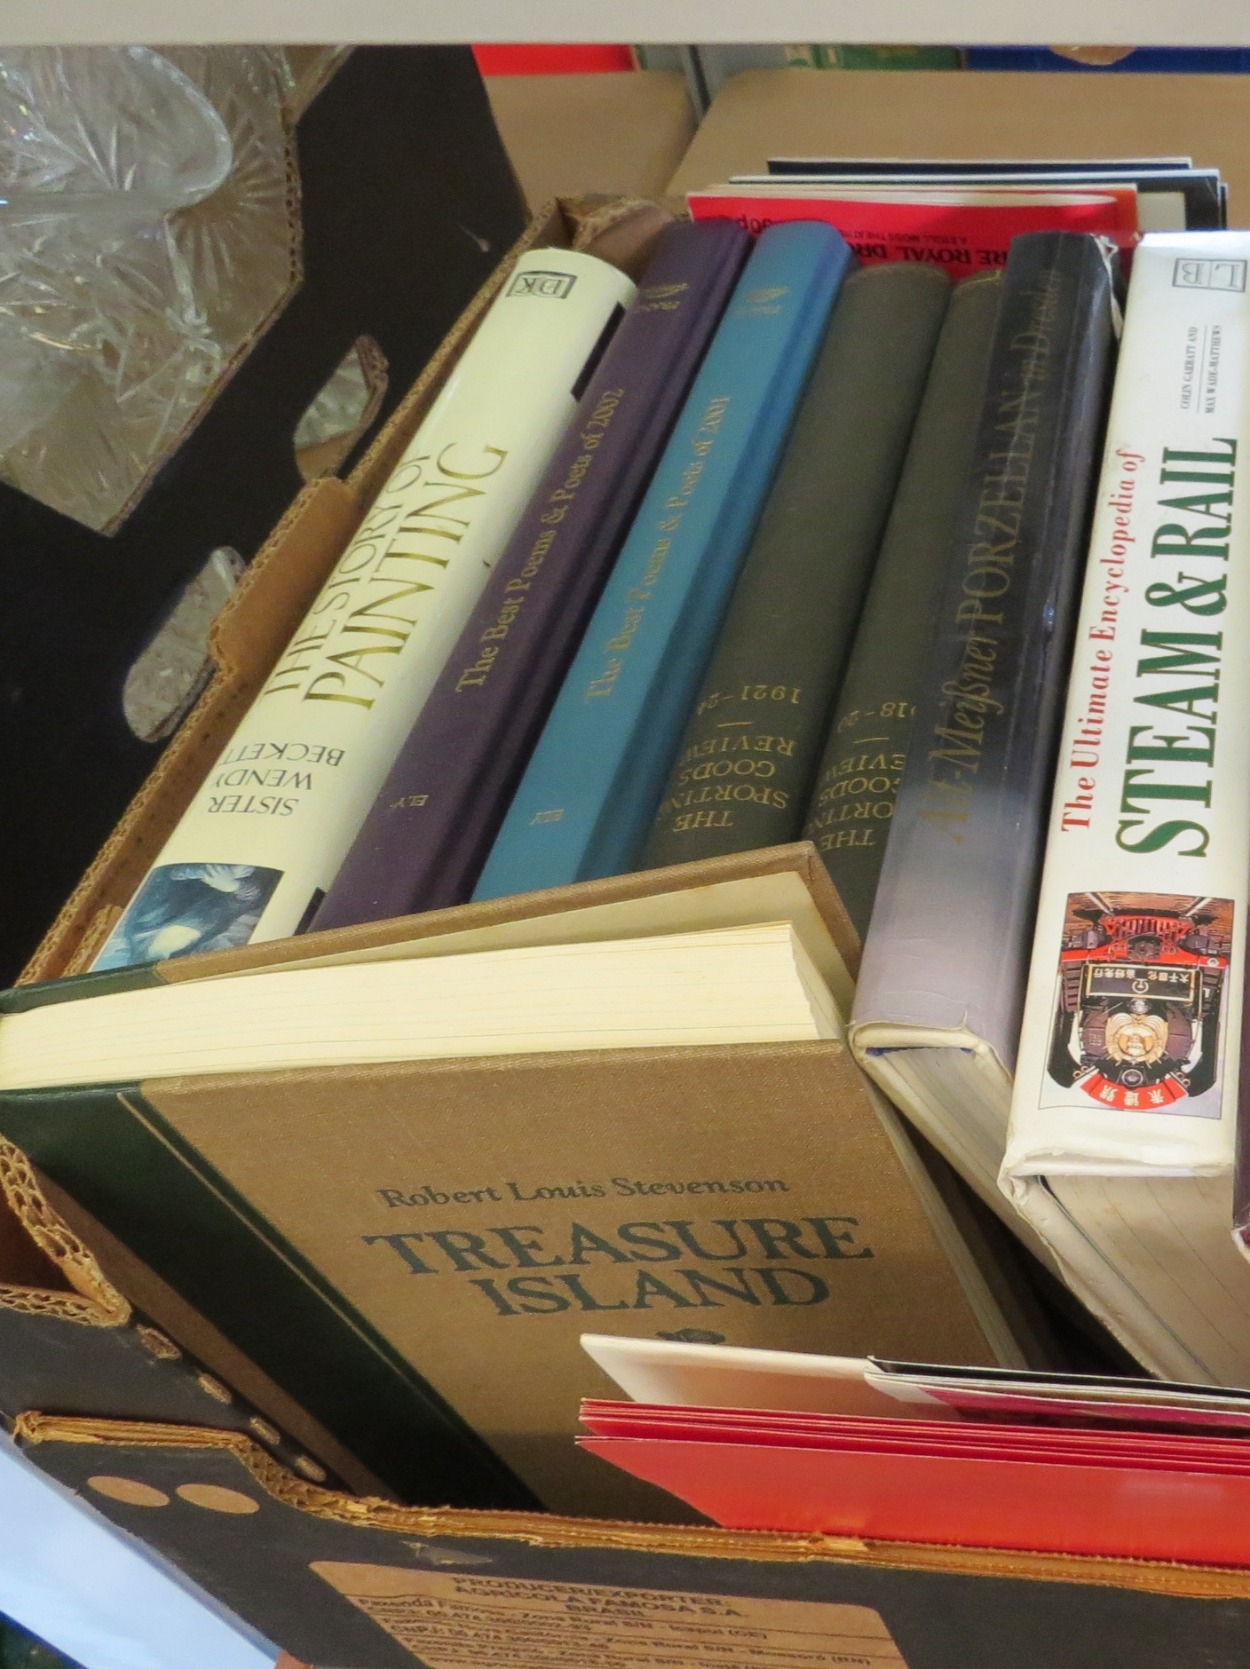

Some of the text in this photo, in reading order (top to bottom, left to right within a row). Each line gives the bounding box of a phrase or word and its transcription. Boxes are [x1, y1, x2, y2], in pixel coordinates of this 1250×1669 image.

[899, 244, 972, 265] ROYAL
[521, 276, 564, 296] DK
[1204, 398, 1216, 414] MAX
[955, 391, 1045, 625] PORZELLAN
[454, 387, 625, 694] The Best Poems & Poets of 2002
[303, 442, 509, 712] PAINTING
[1060, 448, 1146, 832] The Ultimate Encyclopedia of
[1115, 437, 1238, 858] STEAM & RAIL
[584, 656, 623, 704] The
[220, 742, 346, 768] BECKETT
[678, 758, 777, 786] GOODS
[207, 795, 300, 817] SISTER
[658, 784, 792, 817] SPORTIN
[818, 775, 900, 807] OODS
[672, 809, 735, 833] THE
[820, 828, 876, 851] THE
[376, 1176, 791, 1209] Robert Louis Stevenson
[361, 1215, 875, 1276] TREASURE
[467, 1266, 831, 1318] ISLAND
